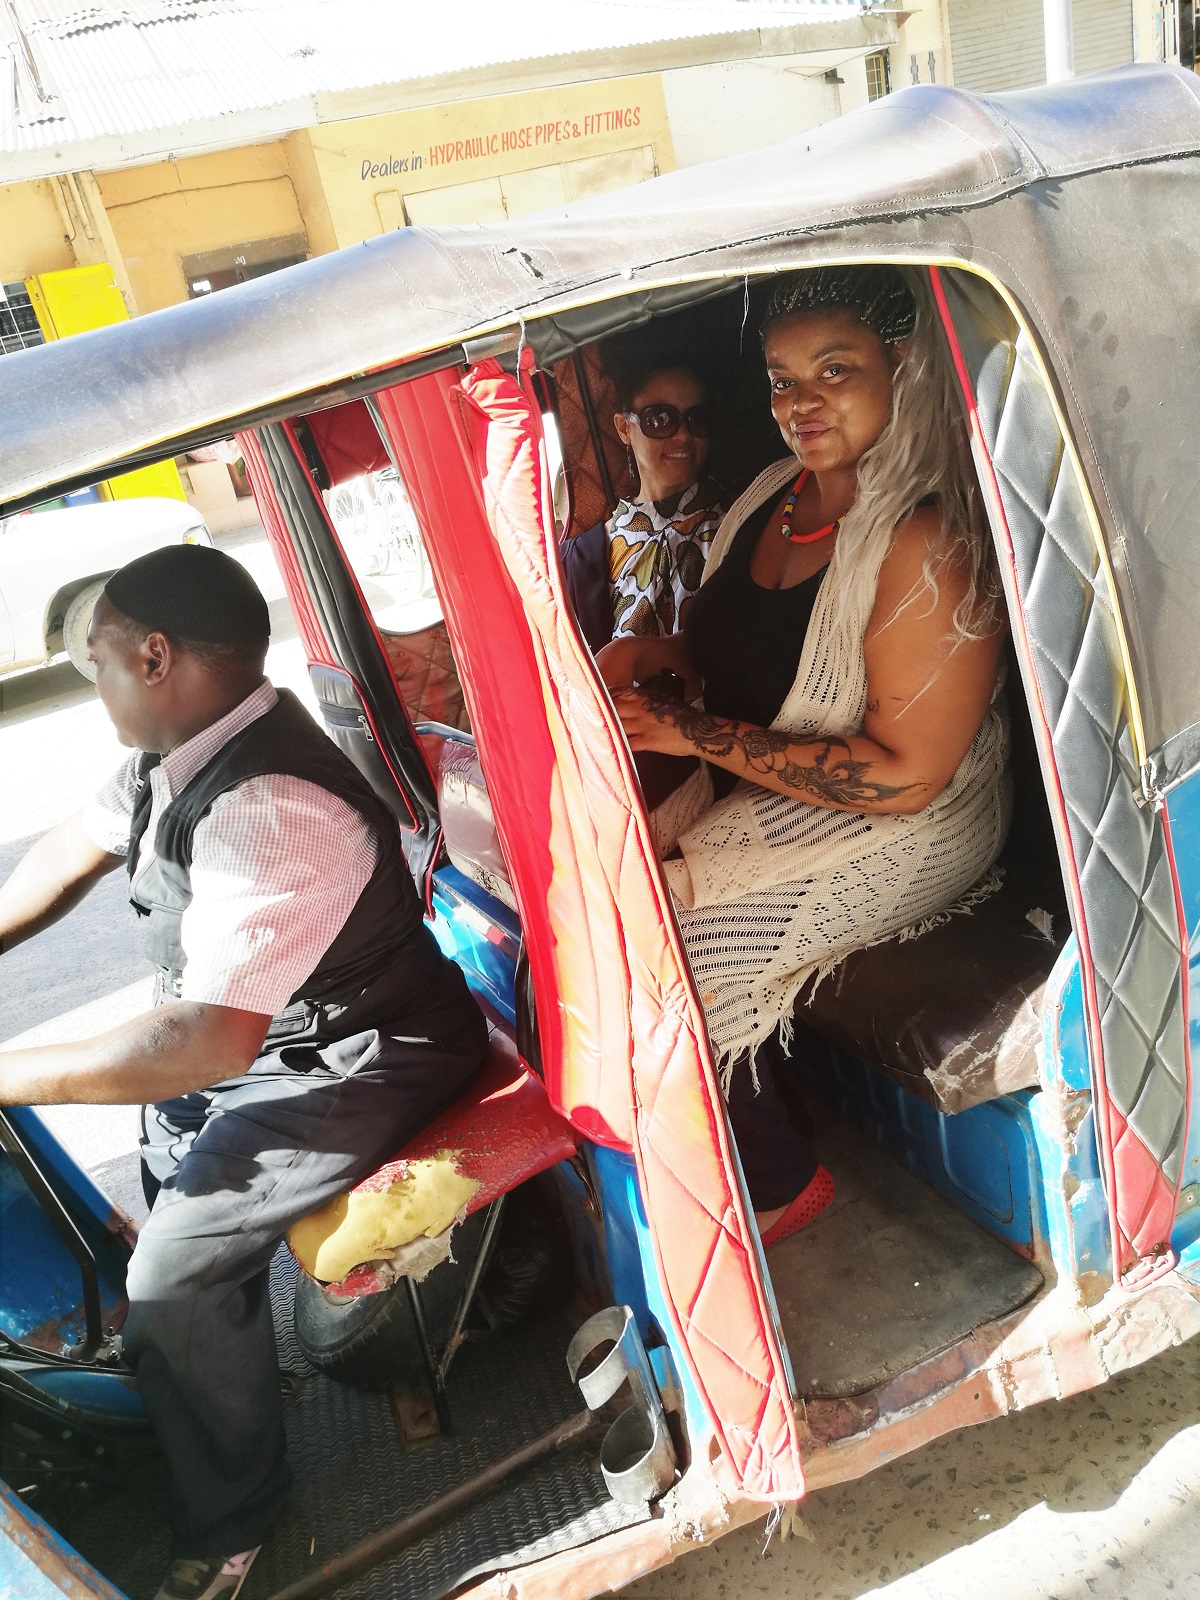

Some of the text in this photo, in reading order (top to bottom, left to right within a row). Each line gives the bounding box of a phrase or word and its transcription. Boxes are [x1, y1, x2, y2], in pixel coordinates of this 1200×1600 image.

[361, 155, 409, 180] Dealers
[429, 134, 499, 167] HYDRAULIC
[501, 127, 533, 152] HOSE
[535, 120, 571, 145] PIPES
[572, 123, 581, 138] &
[584, 106, 641, 136] FITTINGS
